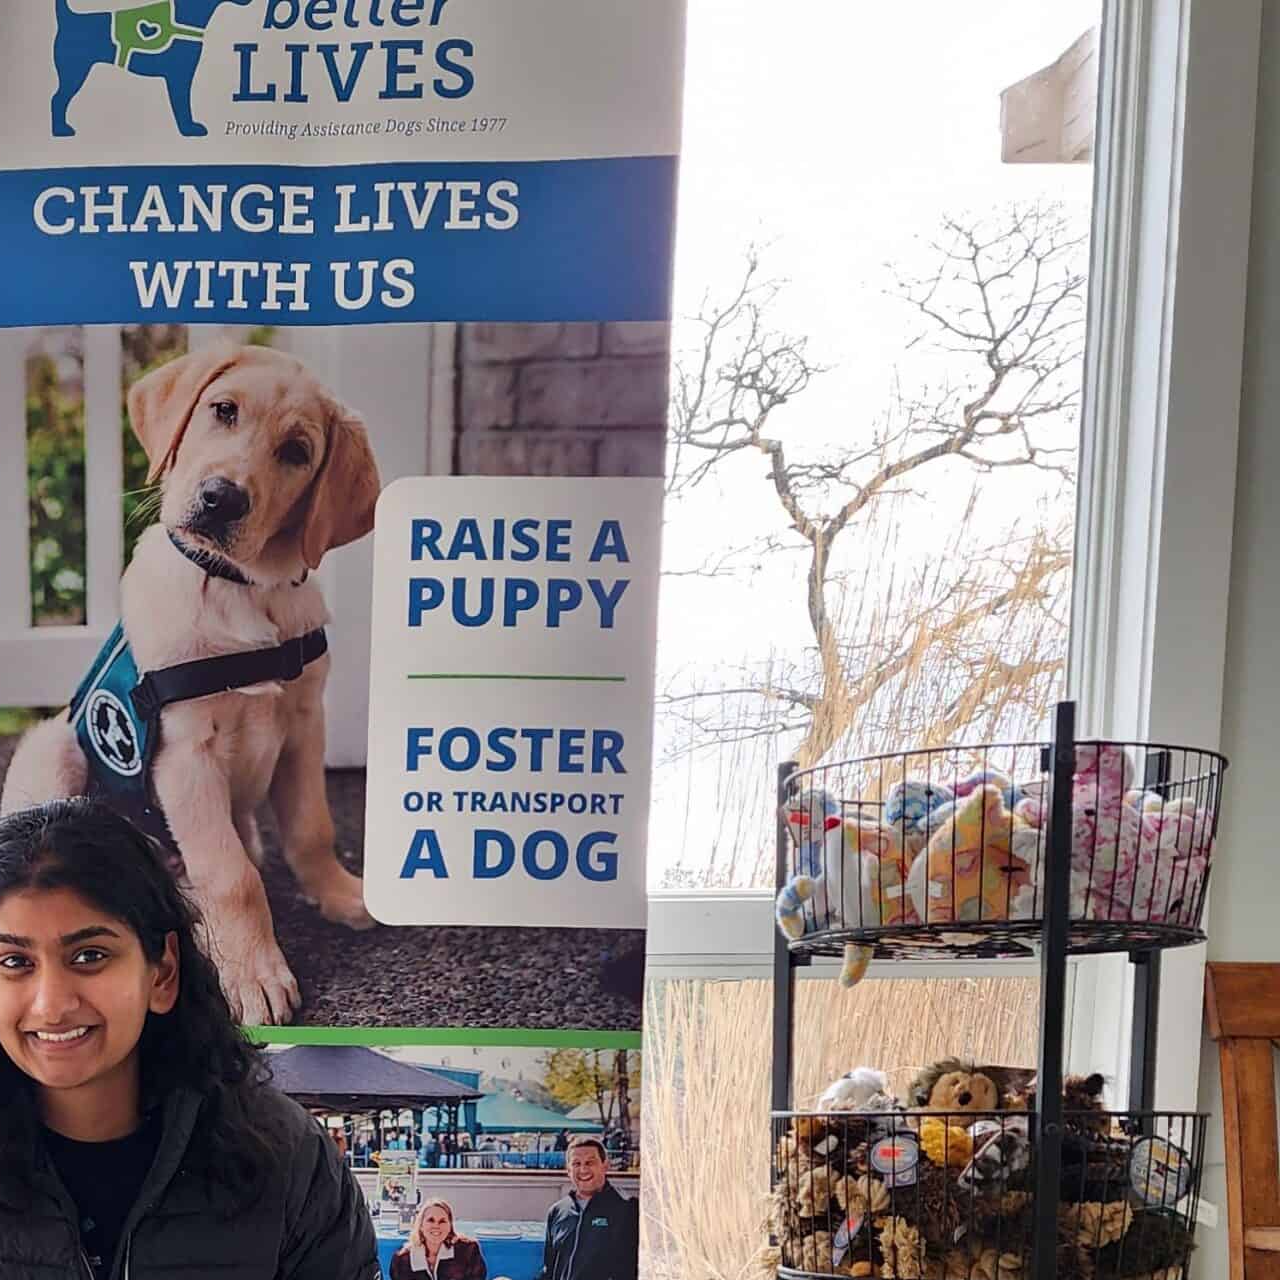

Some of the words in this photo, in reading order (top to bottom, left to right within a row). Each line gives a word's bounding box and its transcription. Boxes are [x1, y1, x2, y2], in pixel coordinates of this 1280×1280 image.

[232, 38, 475, 103] LIVES
[224, 119, 298, 141] Providing
[300, 120, 381, 137] Assistance
[384, 118, 422, 136] Dogs
[426, 117, 467, 133] Since
[470, 117, 508, 133] 1977
[33, 183, 314, 235] CHANGE
[334, 180, 519, 233] LIVES
[128, 260, 311, 311] WITH
[329, 259, 415, 310] US
[410, 518, 573, 562] RAISE
[588, 519, 630, 563] A
[407, 577, 631, 629] PUPPY
[406, 726, 627, 775] FOSTER
[403, 791, 444, 813] OR
[452, 791, 625, 815] TRANSPORT
[399, 829, 450, 879] A
[472, 829, 619, 882] DOG
